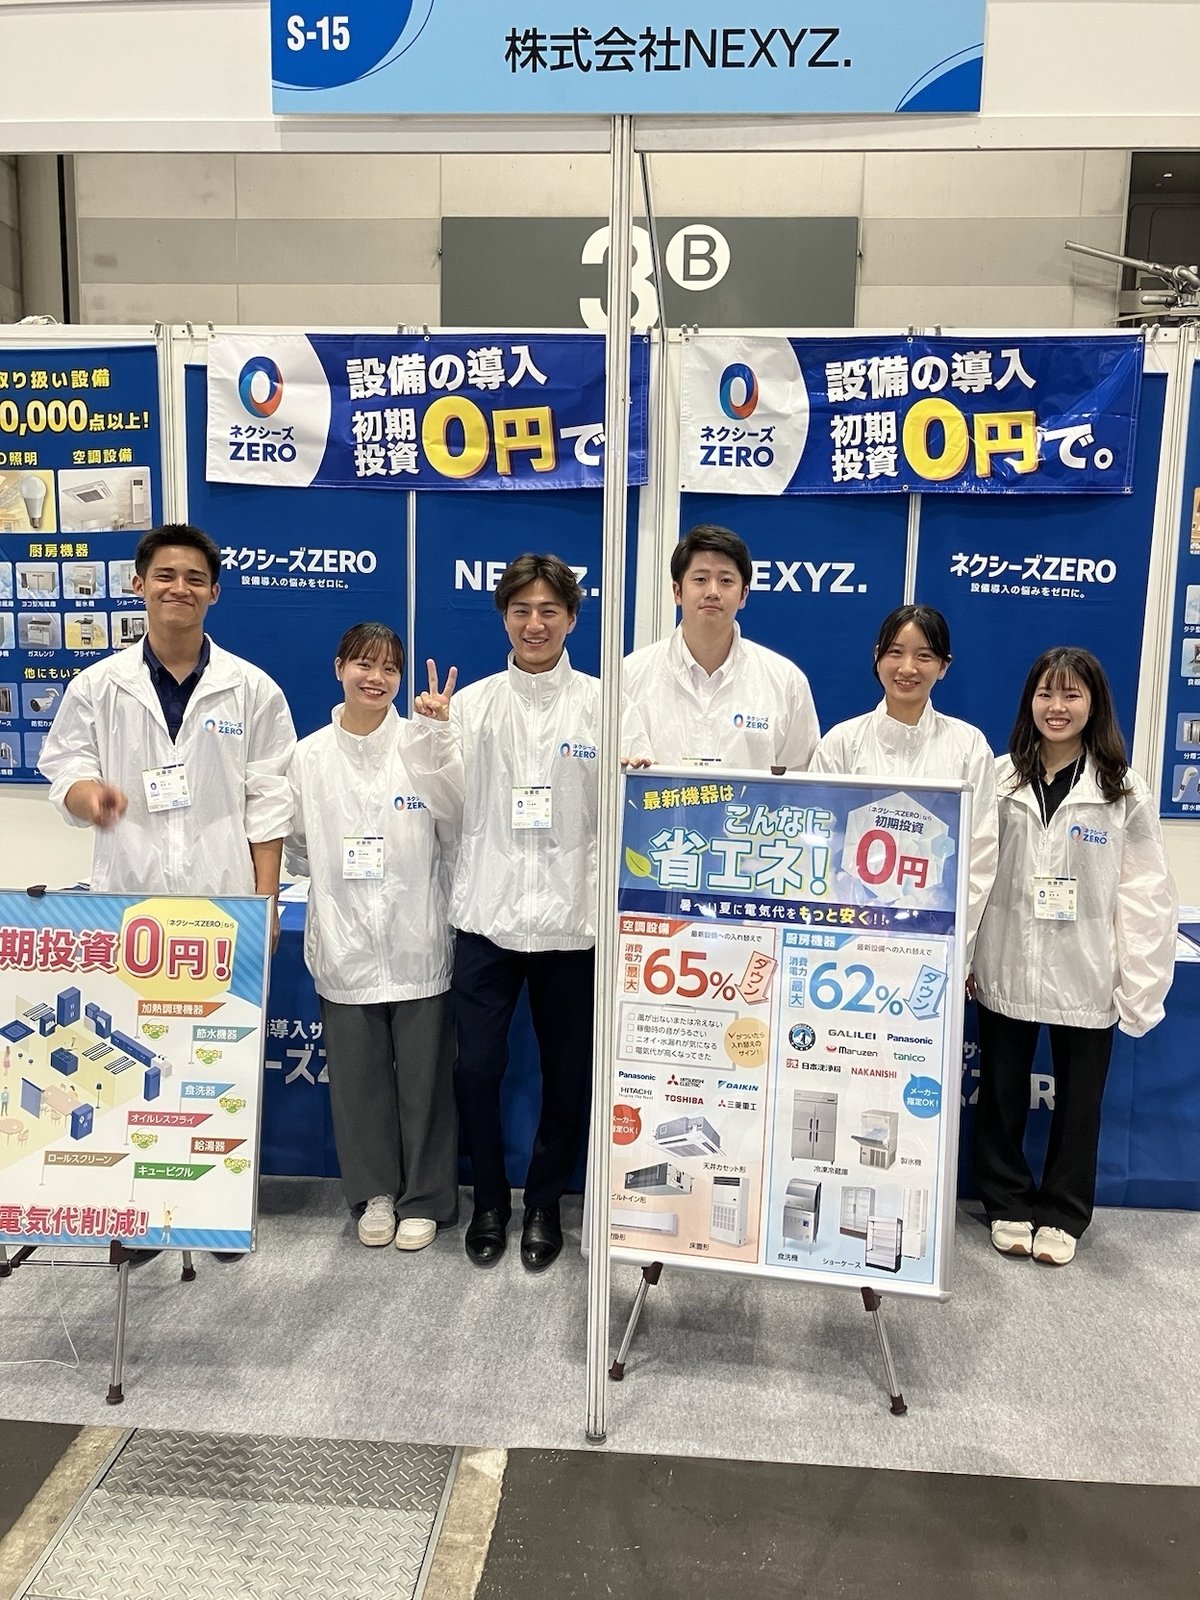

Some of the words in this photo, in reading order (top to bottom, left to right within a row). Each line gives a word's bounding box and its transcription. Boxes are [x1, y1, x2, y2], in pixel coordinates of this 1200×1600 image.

[286, 15, 350, 51] S-15
[504, 26, 852, 73] 株式会社NEXYZ.
[579, 225, 660, 329] 3
[683, 234, 718, 281] B
[346, 345, 548, 400] 設備の導入
[824, 349, 1036, 403] 設備の導入
[229, 426, 294, 441] ネクシーズ
[351, 408, 417, 443] 初期
[830, 412, 896, 447] 初期
[700, 426, 775, 444] ネクシーズ
[72, 448, 133, 464] 空調設備
[229, 441, 297, 463] ZERO
[353, 442, 420, 478] 投資
[700, 445, 774, 468] ZERO
[831, 446, 899, 483] 投資
[29, 544, 89, 558] 厨房機器
[220, 546, 377, 574] ネクシーズZERO
[950, 552, 1117, 583] ネクシーズZERO
[241, 575, 349, 589] 設備導入の悩みをゼロに。
[750, 561, 867, 593] EXYZ.
[970, 583, 1085, 598] 設備導入の悩みをゼロに。
[218, 727, 243, 735] ZERO
[746, 721, 769, 730] ZERO
[573, 750, 596, 759] ZERO
[642, 784, 734, 810] 最新機器は
[724, 805, 831, 838] こんなに
[875, 815, 924, 834] 初期投資
[1083, 834, 1107, 845] ZERO
[649, 827, 828, 896] 省エネ!
[857, 829, 929, 888] 0円
[622, 920, 670, 935] 空調設備
[785, 932, 836, 947] 厨房機器
[643, 948, 736, 1000] 65%
[744, 957, 771, 996] ダウン
[809, 962, 903, 1015] 62%
[913, 972, 941, 1010] ダウン
[141, 1003, 204, 1014] 加熱調理機器
[196, 1028, 237, 1040] 節水機器
[267, 1019, 322, 1040] 導入サ
[828, 1029, 876, 1040] GALILEI
[887, 1033, 933, 1045] Panasonic
[893, 1052, 926, 1062] tanico
[618, 1070, 656, 1081] Panasonic
[851, 1067, 897, 1079] NAKANISHI
[620, 1087, 653, 1096] HITACHI
[726, 1082, 759, 1092] DAIKIN
[910, 1088, 939, 1097] メーカー
[665, 1094, 704, 1105] TOSHIBA
[131, 1113, 195, 1125] オイルレスフライ
[48, 1153, 112, 1164] ロールスクリーン
[138, 1165, 194, 1177] キュービクル
[0, 1205, 149, 1236] 電気代削減!
[823, 1258, 861, 1269] ショーケース
